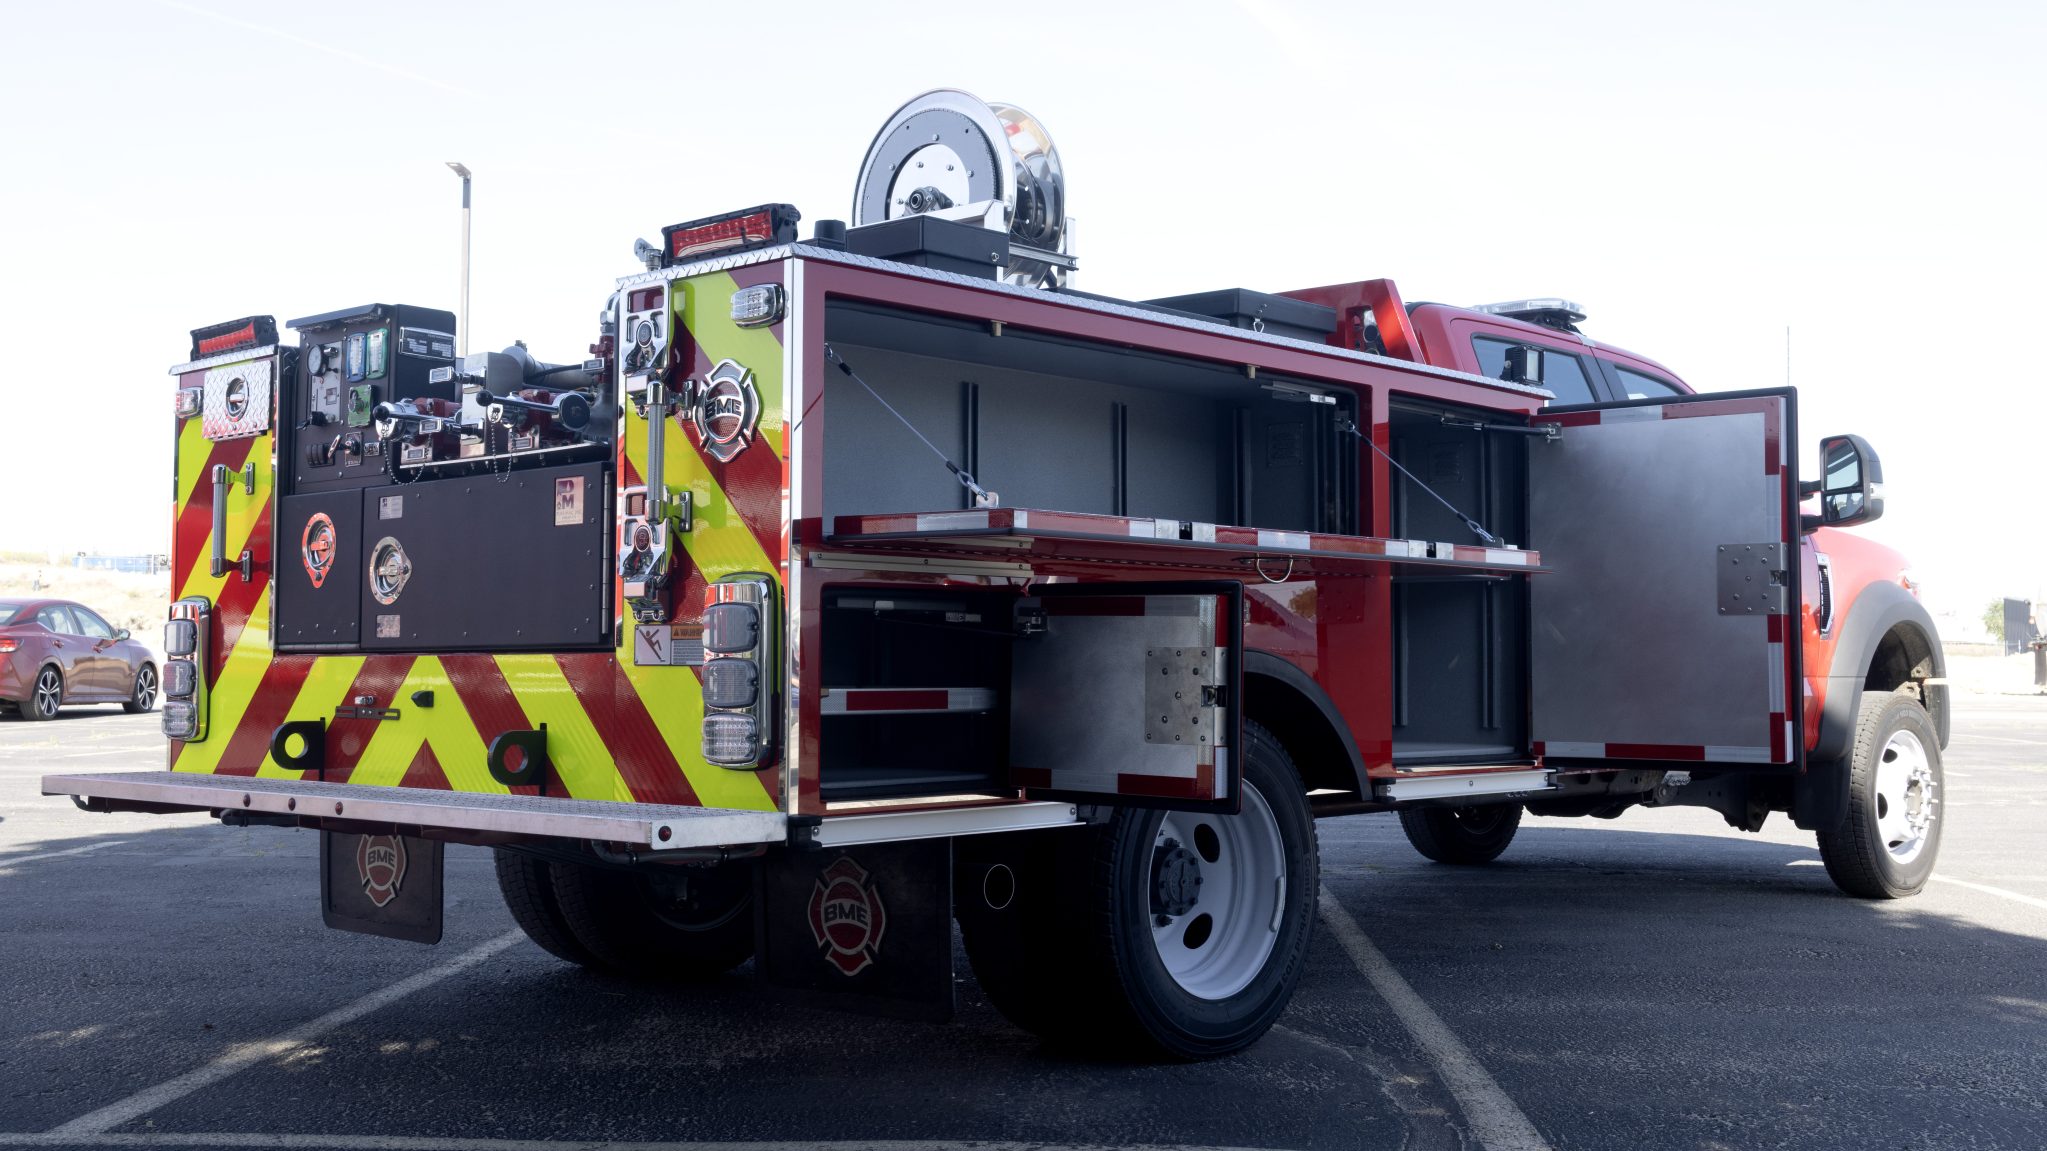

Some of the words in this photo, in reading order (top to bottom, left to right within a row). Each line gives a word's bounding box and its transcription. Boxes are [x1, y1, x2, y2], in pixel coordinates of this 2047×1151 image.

[704, 398, 742, 420] BME
[367, 849, 396, 868] BME
[824, 902, 868, 926] BME
